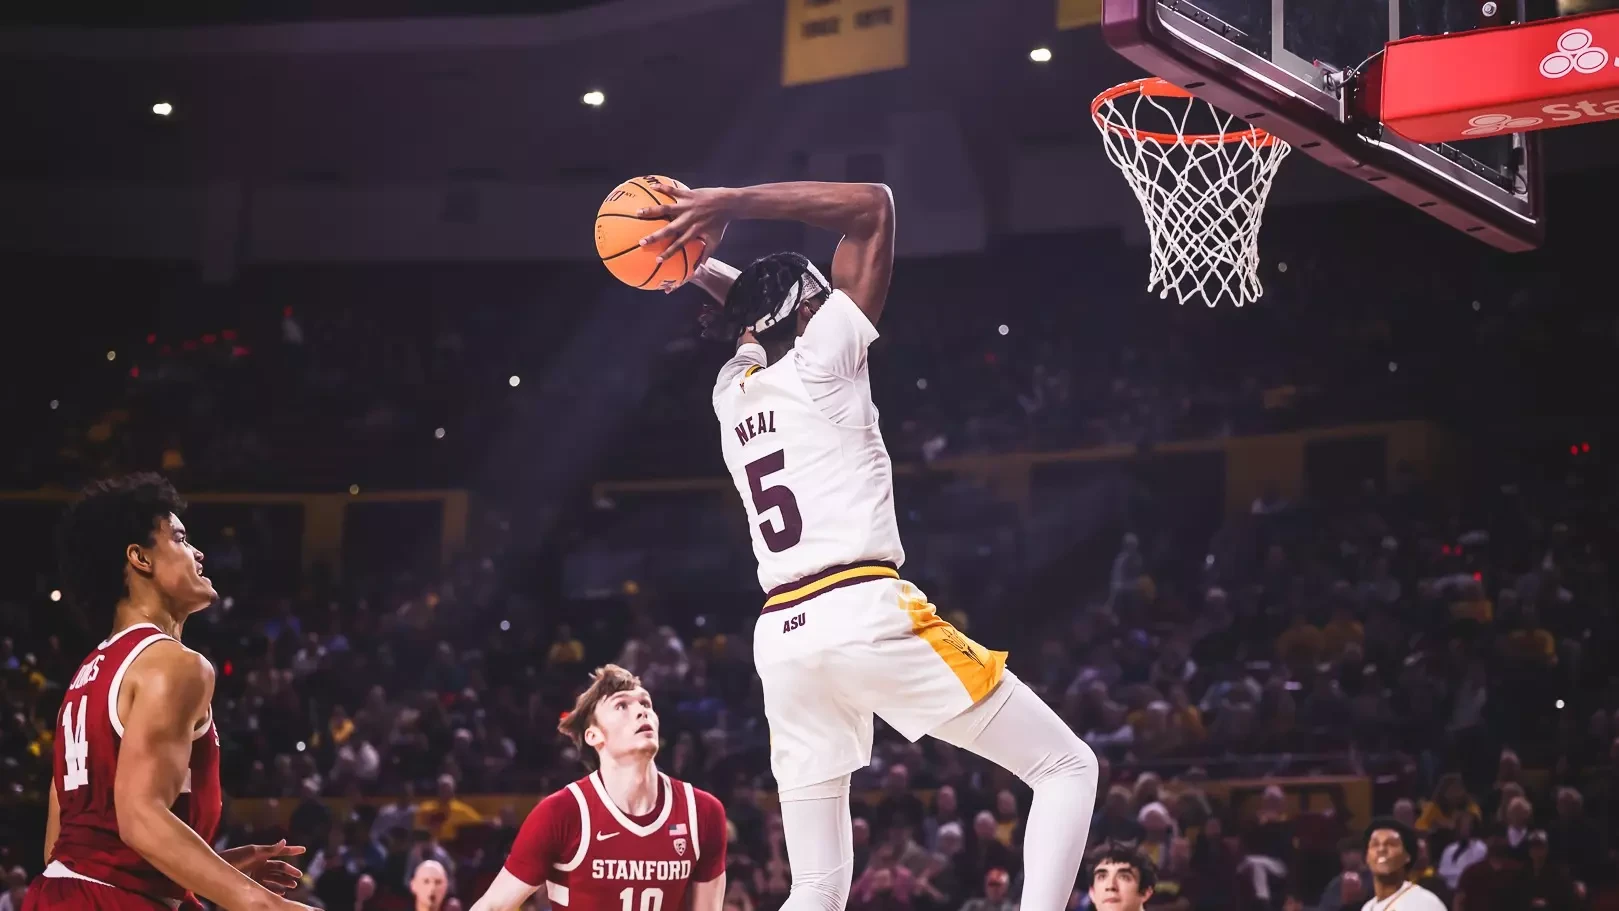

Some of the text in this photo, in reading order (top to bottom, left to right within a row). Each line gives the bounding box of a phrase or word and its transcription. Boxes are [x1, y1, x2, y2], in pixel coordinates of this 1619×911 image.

[735, 411, 776, 446] NEAL
[745, 449, 802, 553] 5
[783, 612, 806, 634] ASU
[62, 695, 89, 791] 14
[592, 860, 691, 880] STANFORD
[620, 887, 663, 911] 10
